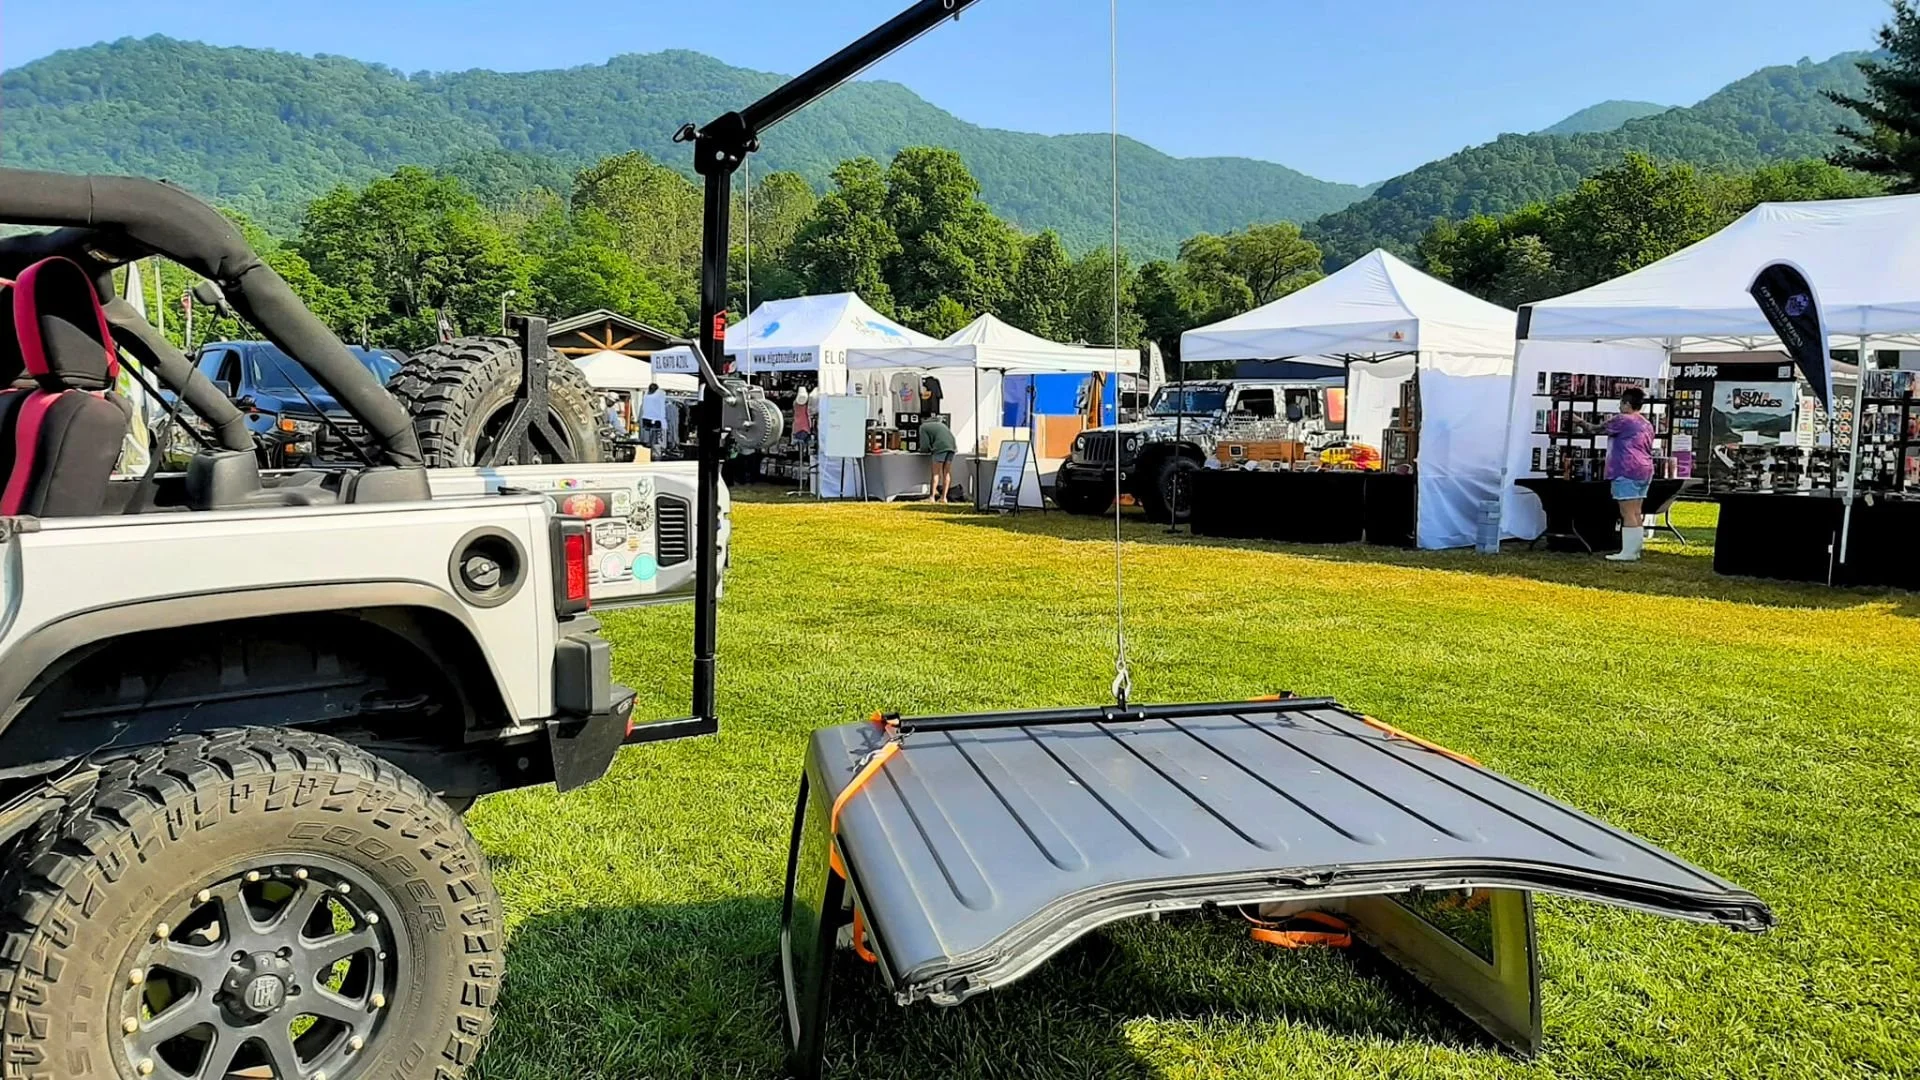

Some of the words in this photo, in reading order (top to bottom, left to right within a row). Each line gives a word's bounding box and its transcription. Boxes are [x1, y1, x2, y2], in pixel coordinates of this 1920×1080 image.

[824, 350, 835, 364] EL
[1684, 363, 1718, 378] SHIELDS
[1741, 390, 1763, 400] SUN
[1740, 398, 1783, 408] SHADES
[287, 821, 447, 934] COOPER
[65, 973, 95, 1076] STT
[91, 885, 155, 965] PRO
